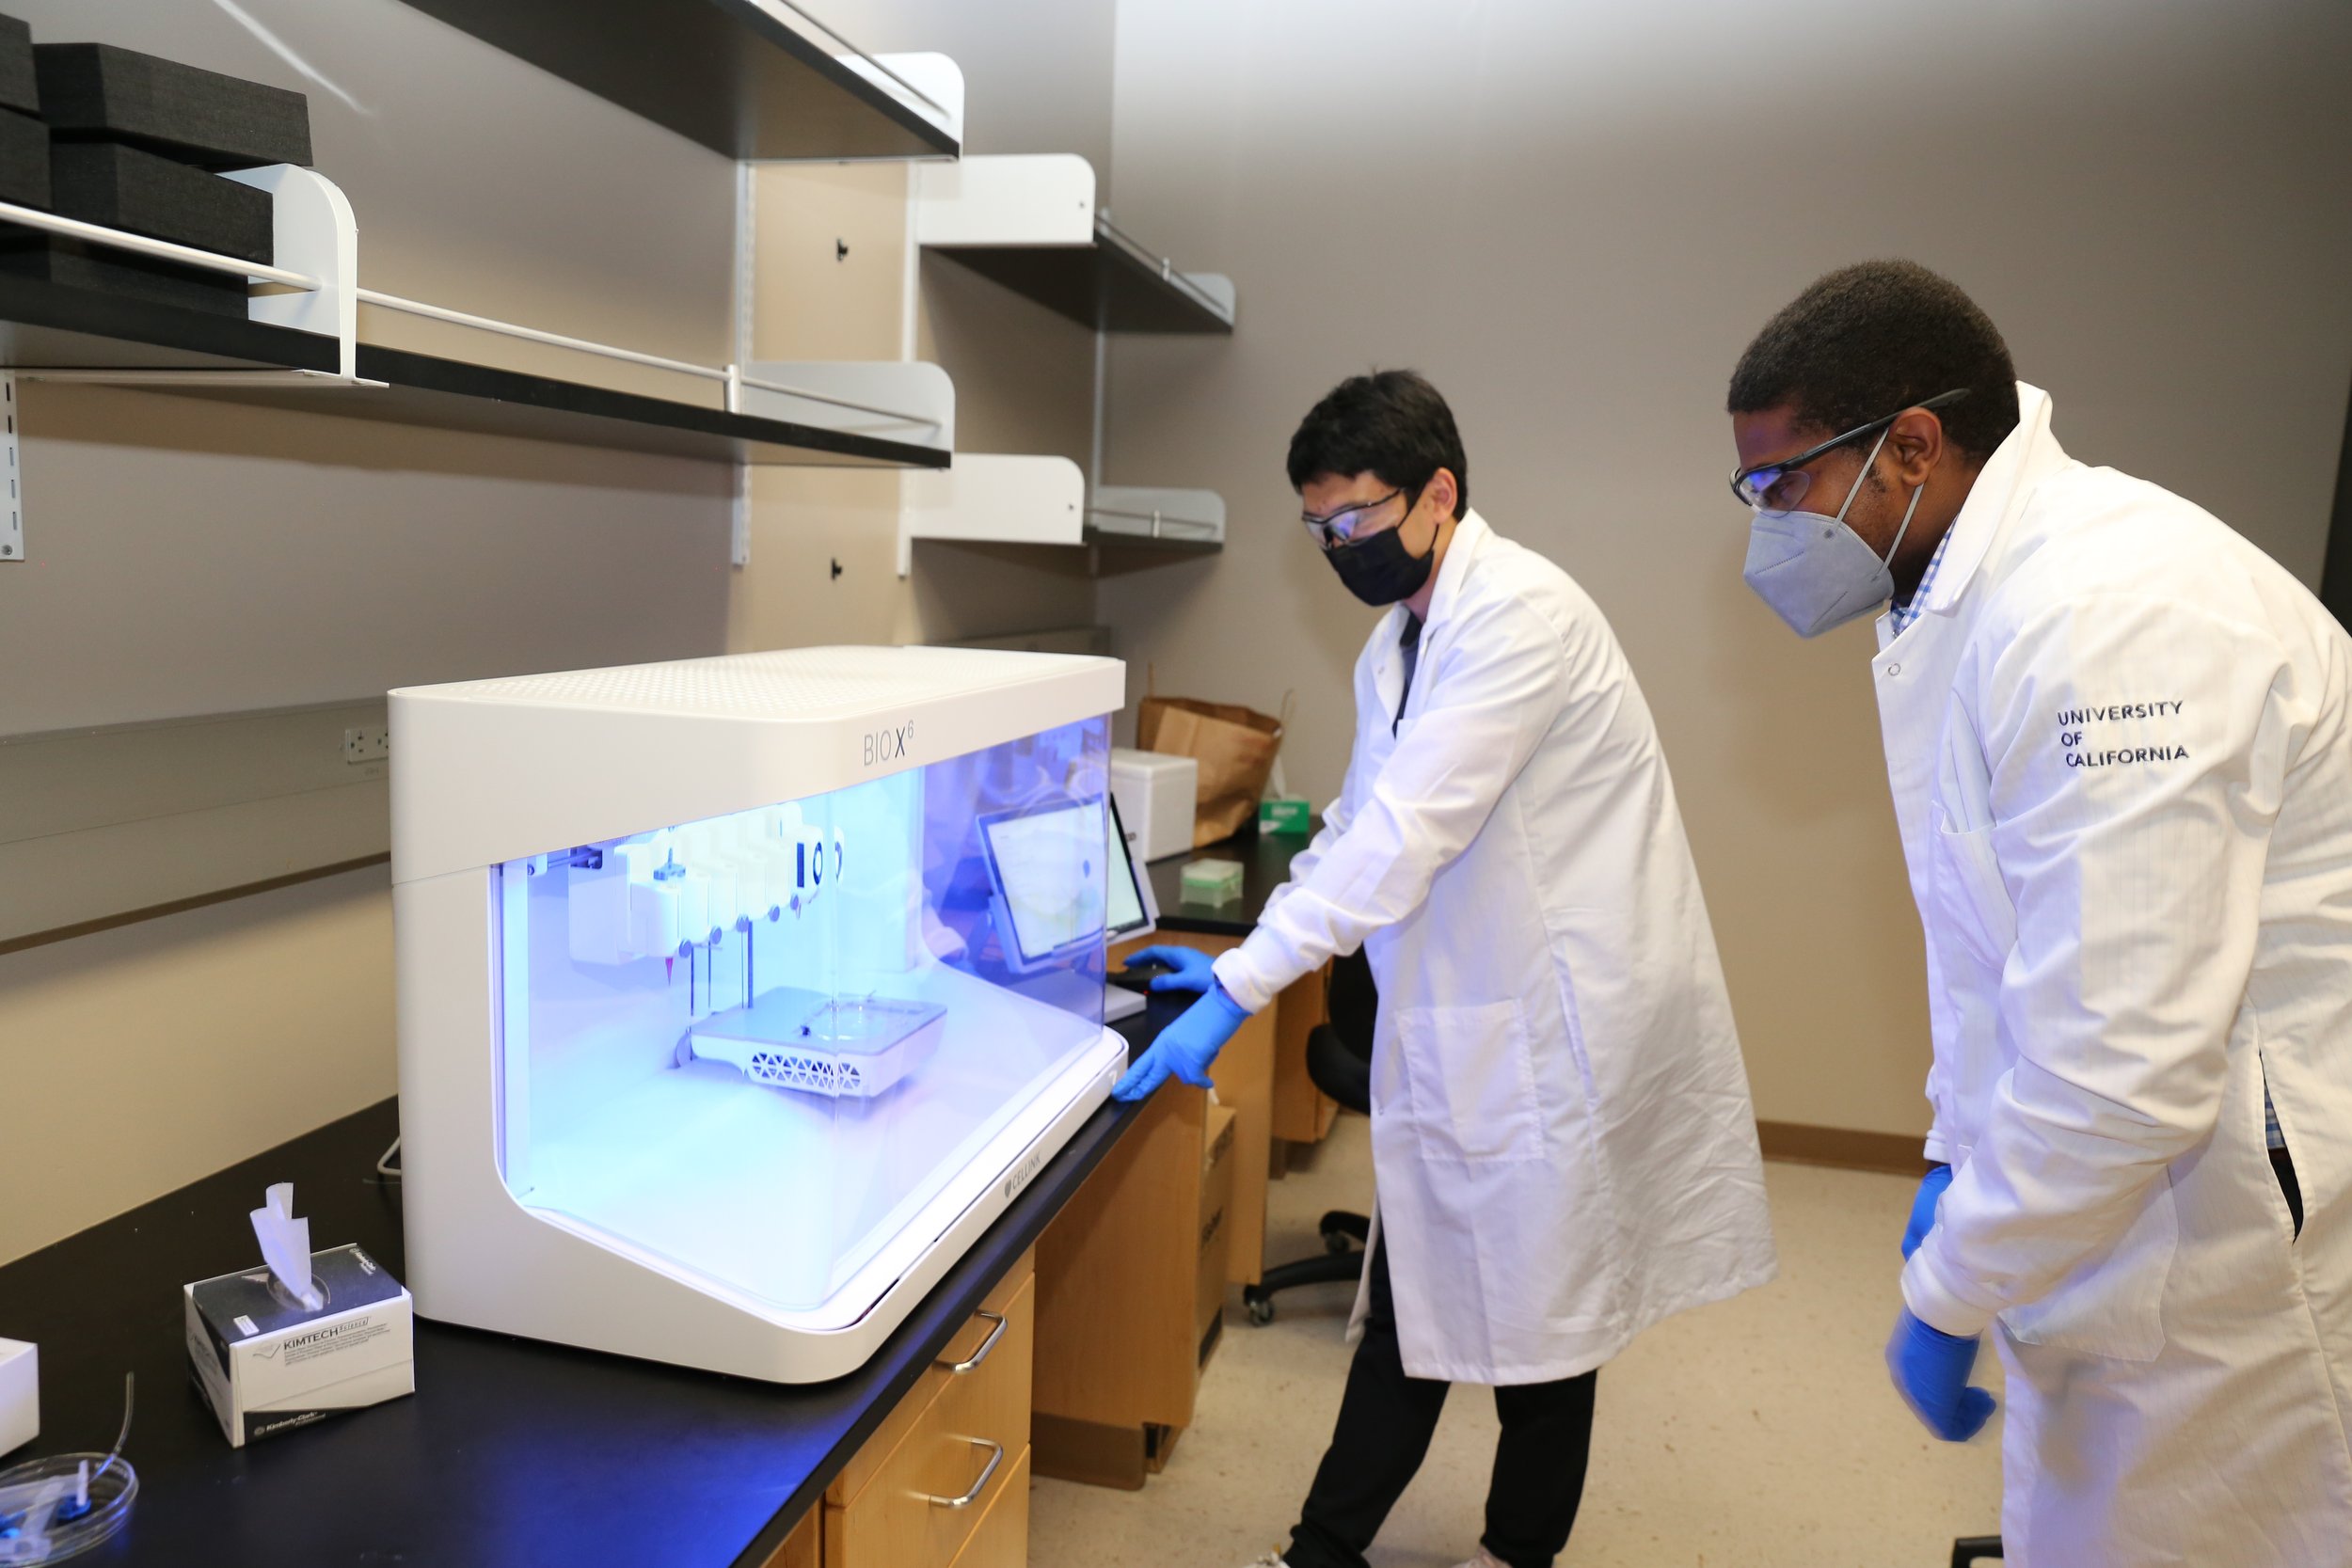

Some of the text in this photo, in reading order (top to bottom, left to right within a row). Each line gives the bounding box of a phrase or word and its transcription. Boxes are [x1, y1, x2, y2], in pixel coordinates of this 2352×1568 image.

[2058, 700, 2184, 726] UNIVERSITY
[2060, 731, 2083, 747] OF
[2065, 745, 2189, 768] CALIFORNIA
[1012, 1150, 1041, 1190] CELLINK
[284, 1327, 339, 1351] KIMTECH
